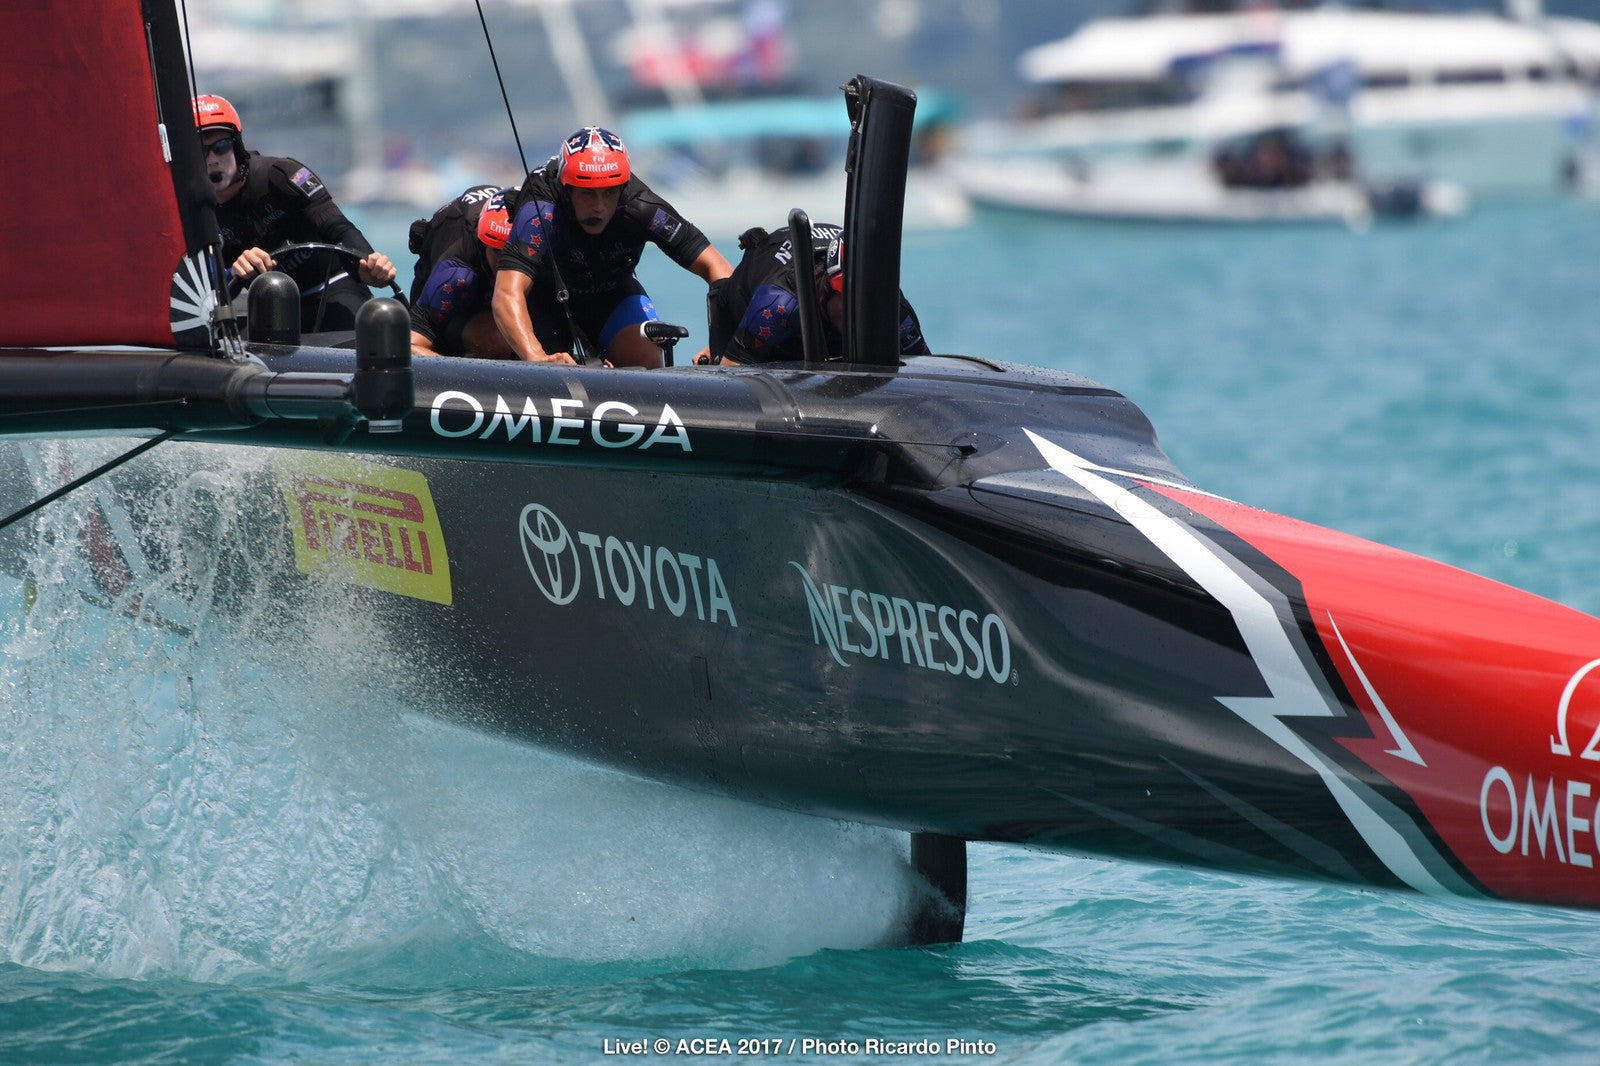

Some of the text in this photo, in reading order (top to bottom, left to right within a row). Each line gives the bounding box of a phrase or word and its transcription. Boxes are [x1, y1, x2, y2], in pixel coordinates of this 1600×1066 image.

[579, 161, 619, 172] Emirates
[430, 390, 692, 452] OMEGA
[291, 471, 434, 575] PIRELLI
[578, 531, 738, 627] TOYOTA
[1480, 765, 1600, 868] OME
